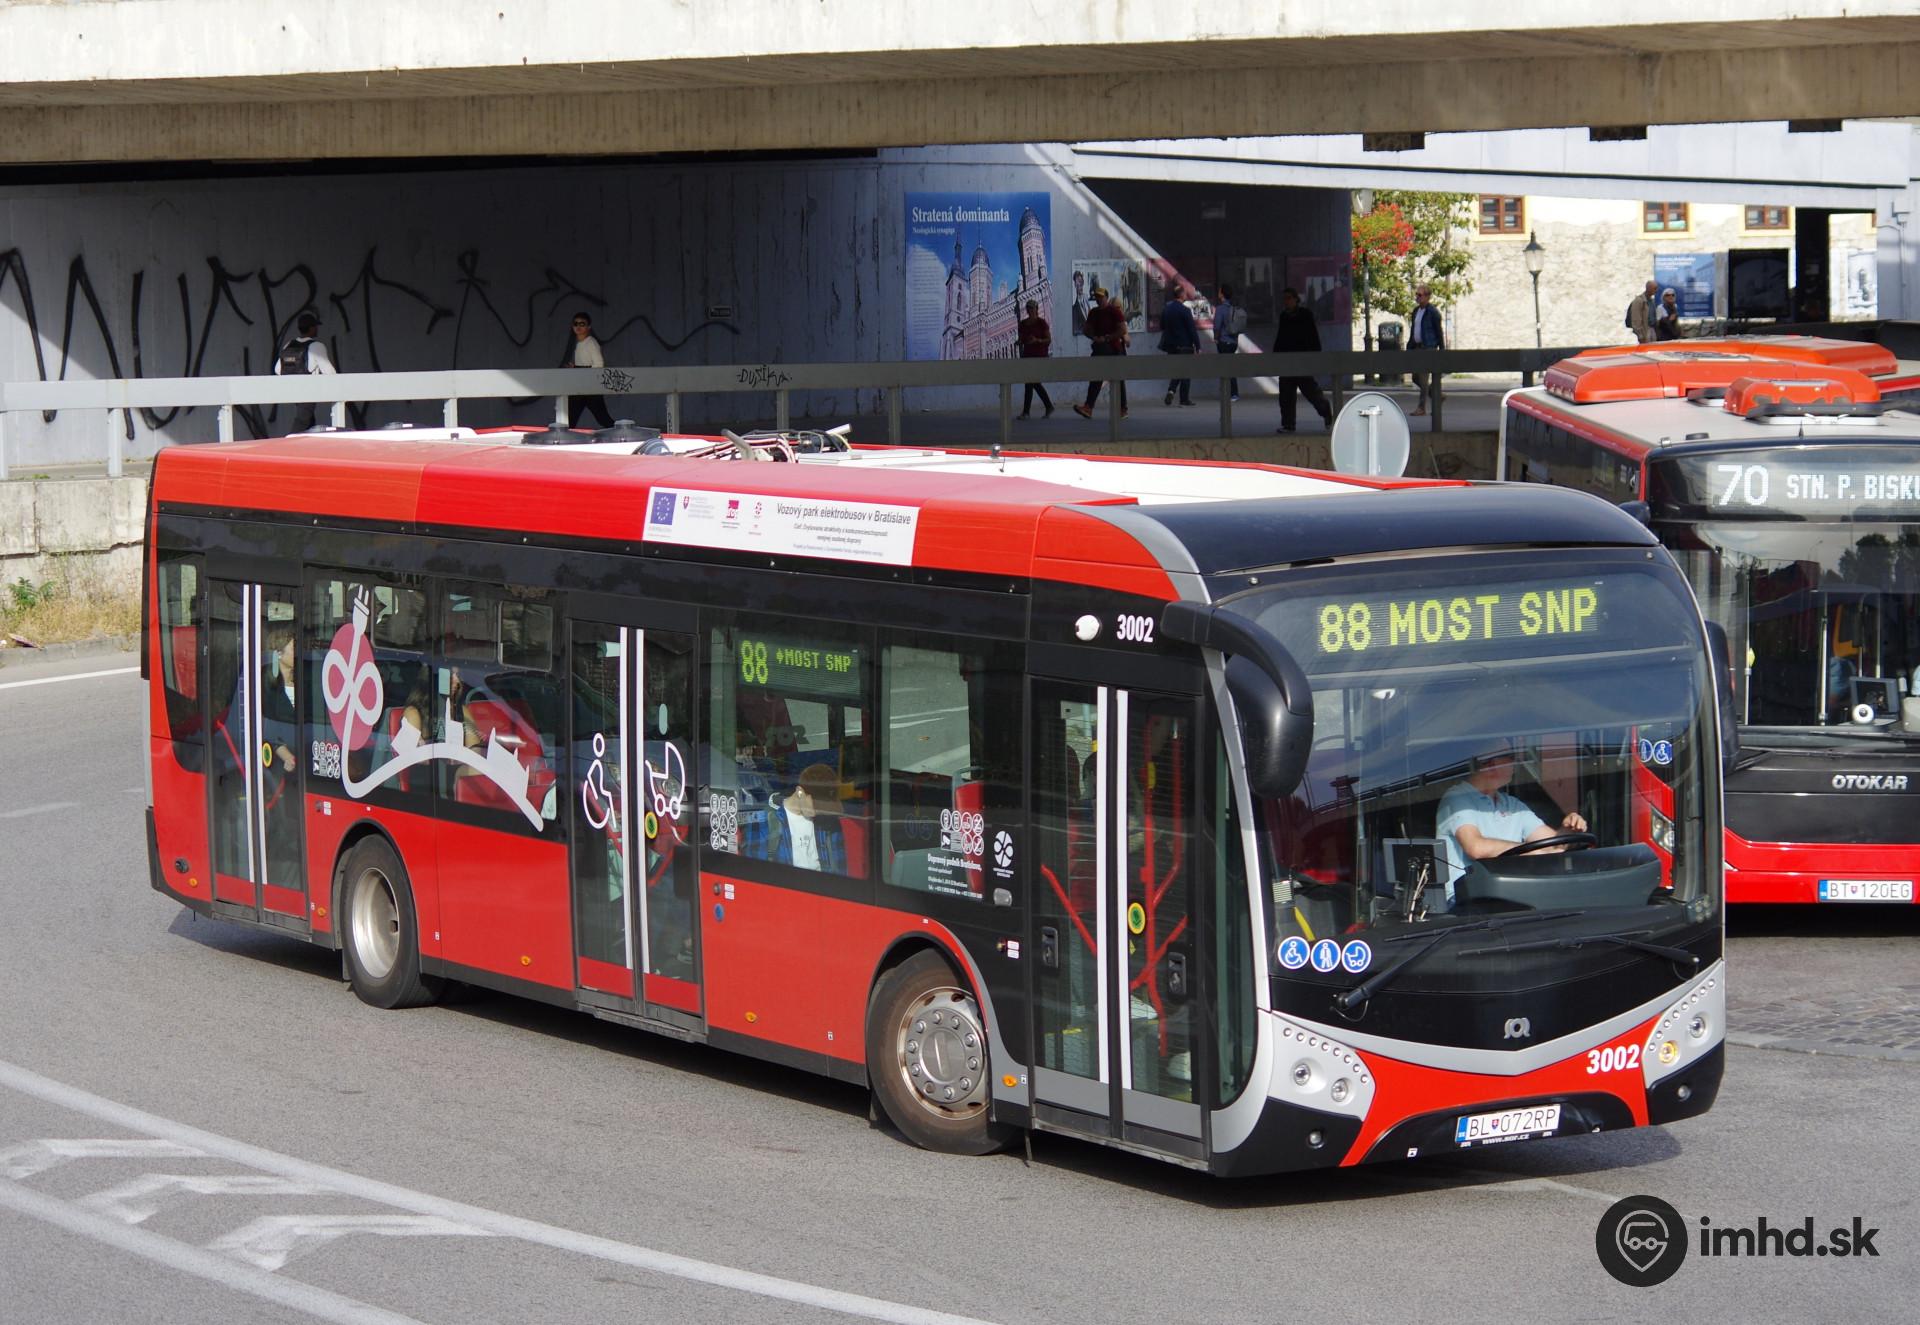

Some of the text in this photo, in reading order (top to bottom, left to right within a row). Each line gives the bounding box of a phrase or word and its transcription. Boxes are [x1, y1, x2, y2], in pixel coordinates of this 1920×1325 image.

[912, 206, 1010, 222] Stratená dominanta
[1718, 464, 1769, 506] 70
[1786, 474, 1829, 500] STN.
[1838, 474, 1856, 500] P.
[777, 503, 802, 519] Vozový
[803, 506, 819, 518] park
[820, 507, 866, 521] elektrobusov
[874, 510, 911, 525] Bratislave
[1116, 613, 1154, 643] 3002
[1319, 588, 1598, 653] 88 MOST SNP
[741, 640, 852, 684] 88 MOST SNP
[1831, 774, 1909, 790] OTOKAR
[1586, 1044, 1640, 1074] 3002
[1469, 1118, 1489, 1137] BL
